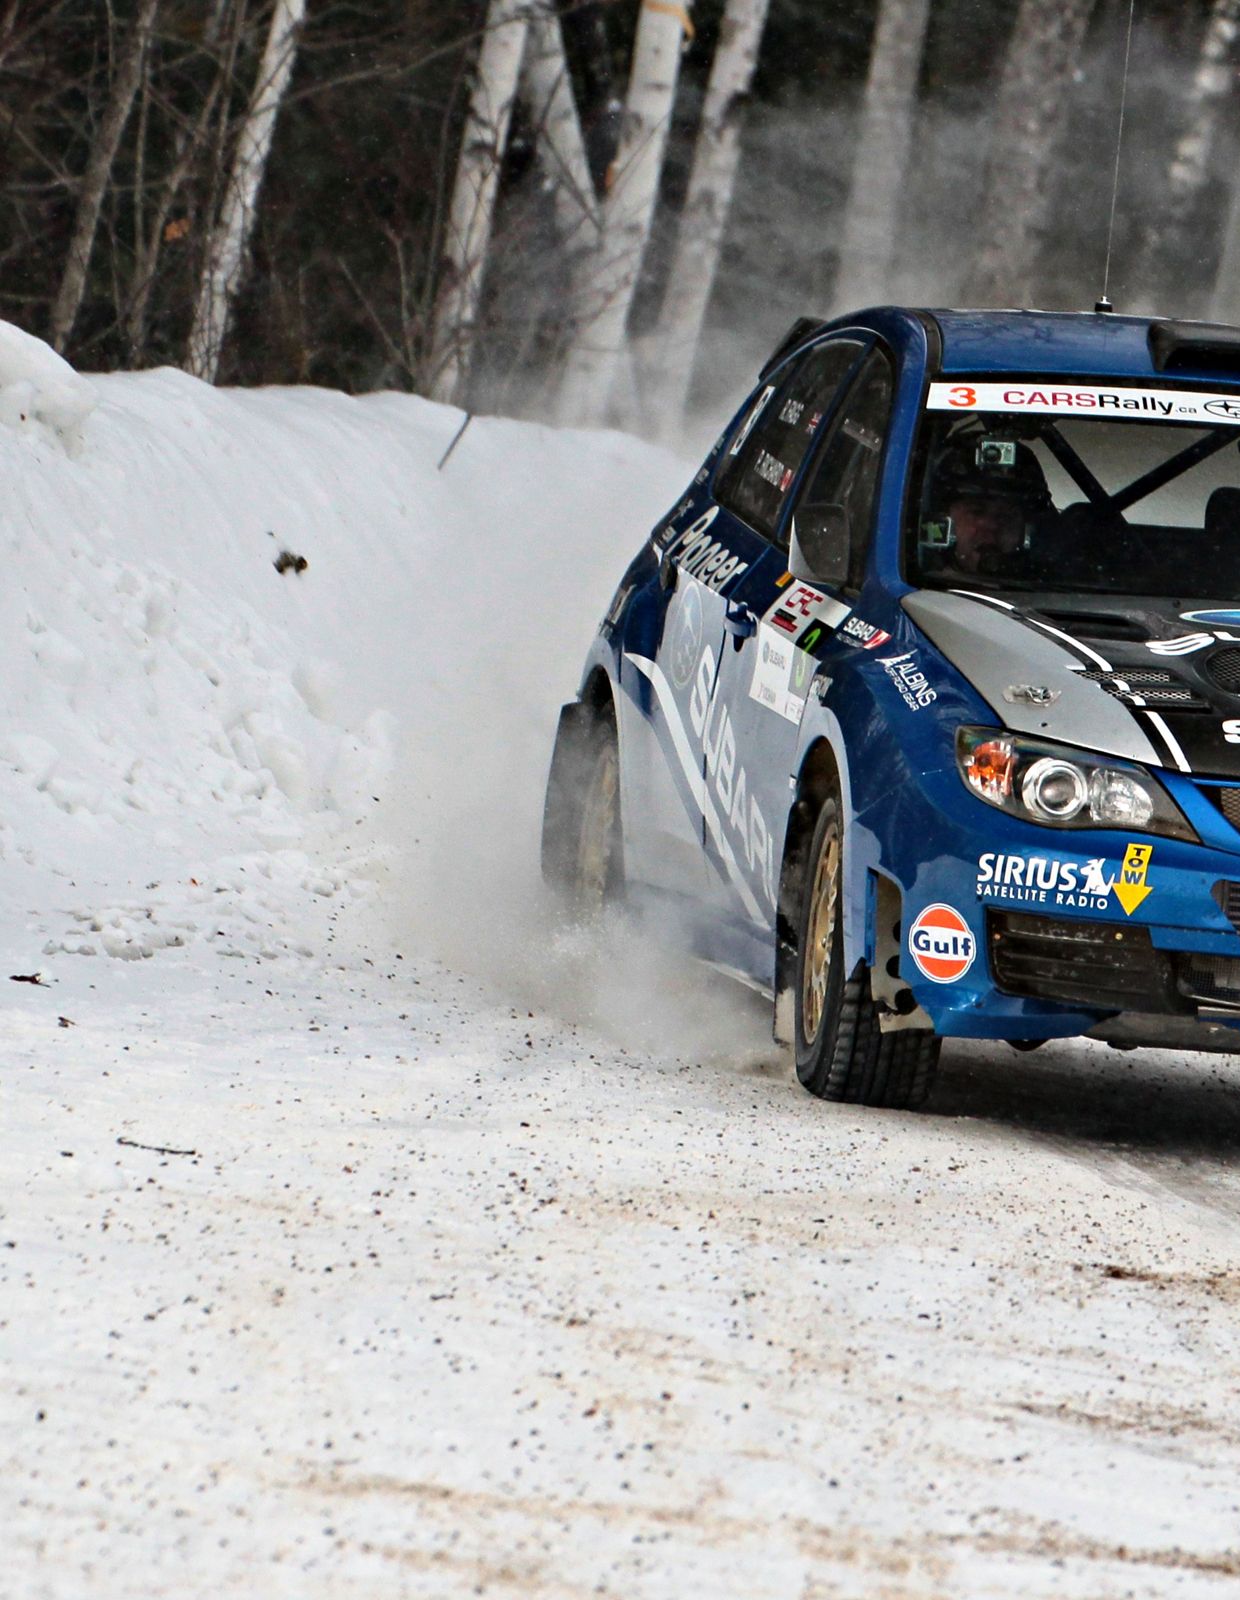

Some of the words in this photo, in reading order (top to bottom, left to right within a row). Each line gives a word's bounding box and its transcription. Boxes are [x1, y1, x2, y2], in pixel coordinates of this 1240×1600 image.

[948, 387, 977, 407] 3
[665, 505, 749, 592] Pioneer
[842, 616, 880, 641] SUBARU
[894, 662, 937, 707] ALBINS
[976, 853, 1079, 892] SIRIUS
[1123, 847, 1147, 883] TOW
[976, 883, 1047, 903] SATELLITE
[1055, 895, 1109, 910] RADIO
[912, 930, 972, 957] Gulf
